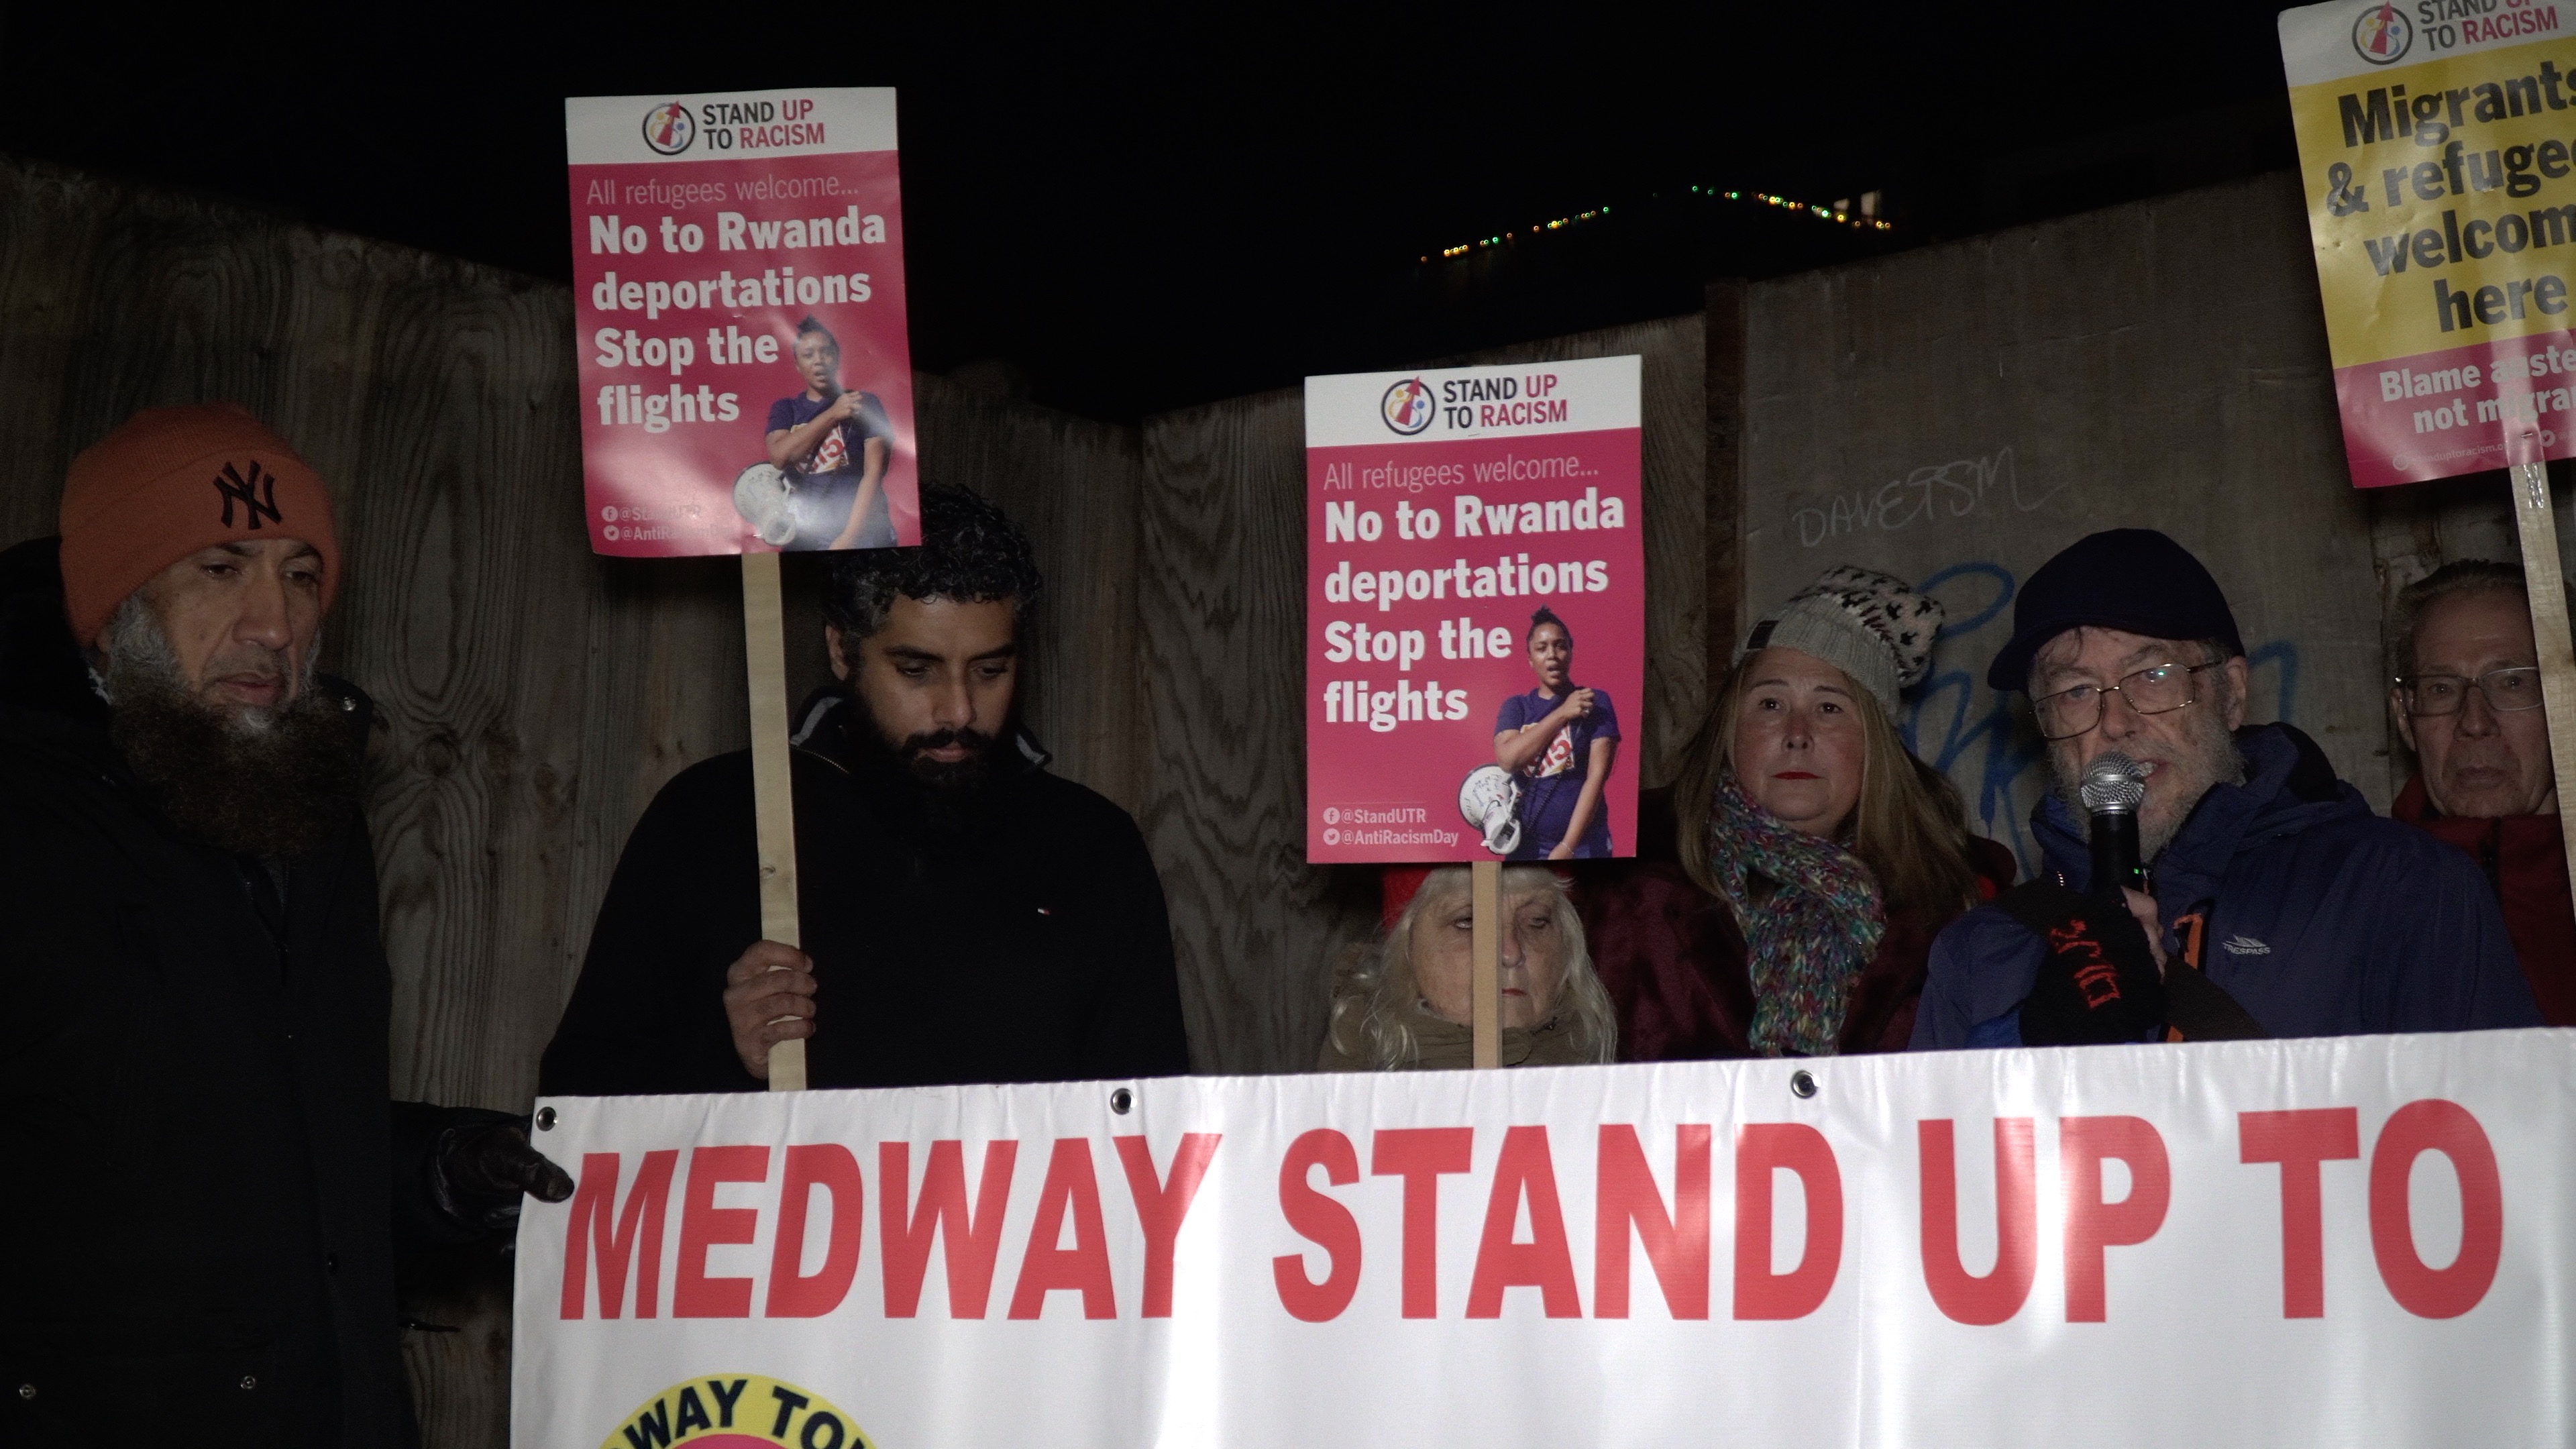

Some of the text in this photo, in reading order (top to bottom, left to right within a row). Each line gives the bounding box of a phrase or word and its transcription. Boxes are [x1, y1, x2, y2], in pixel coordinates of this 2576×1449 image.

[2422, 5, 2559, 52] TO RACISM
[702, 99, 814, 125] STAND UP
[704, 123, 825, 150] TO RACISM
[586, 174, 859, 210] All refugees welcome...
[2326, 138, 2576, 217] & refuge
[589, 205, 886, 255] No to Rwanda
[592, 266, 871, 320] deportations
[2434, 274, 2569, 333] here
[594, 325, 779, 376] Stop the
[596, 383, 740, 433] flights
[1444, 374, 1558, 403] STAND UP
[2379, 364, 2481, 402] Blame
[1444, 400, 1568, 430] TO RACISM
[2412, 386, 2576, 435] not migra
[213, 460, 282, 529] NY
[1324, 453, 1599, 494] All refugees welcome...
[1325, 486, 1625, 543] No to Rwanda
[1324, 553, 1609, 611] deportations
[1324, 616, 1512, 672] Stop the
[1324, 680, 1469, 733] flights
[1342, 807, 1427, 825] @StandUTR
[1342, 828, 1459, 847] @AntiRacismDay
[559, 1098, 2503, 1327] MEDWAY STAND UP TO
[610, 1379, 865, 1449] WAY TO
